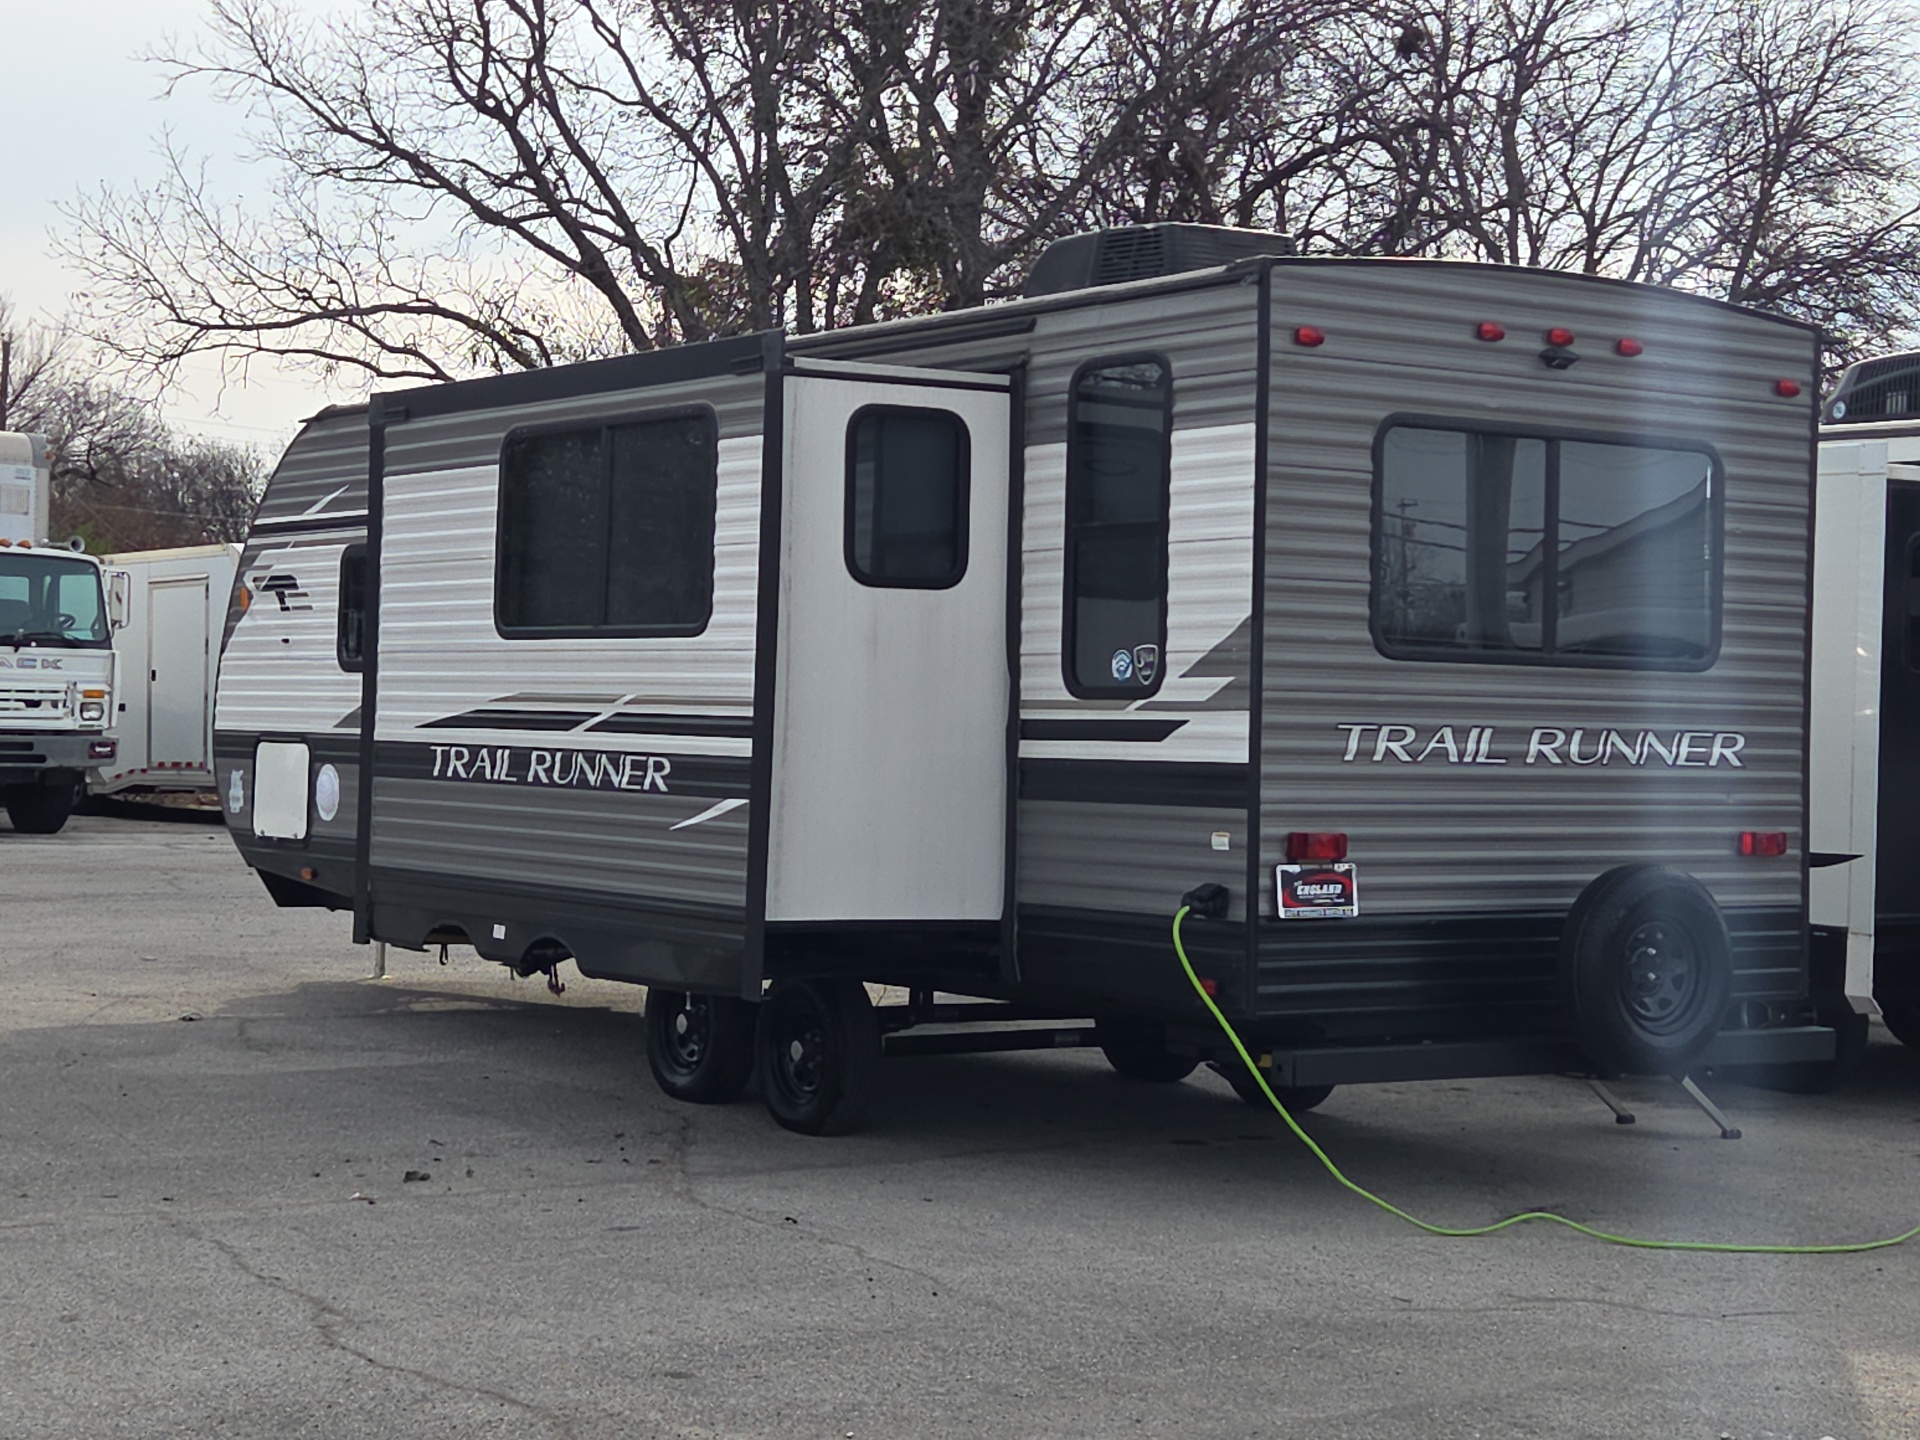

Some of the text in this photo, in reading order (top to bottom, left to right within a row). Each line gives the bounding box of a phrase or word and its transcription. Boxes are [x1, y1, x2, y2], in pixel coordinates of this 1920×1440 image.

[1337, 724, 1745, 767] TRAIL RUNNER
[430, 746, 671, 792] TRAIL RUNNER
